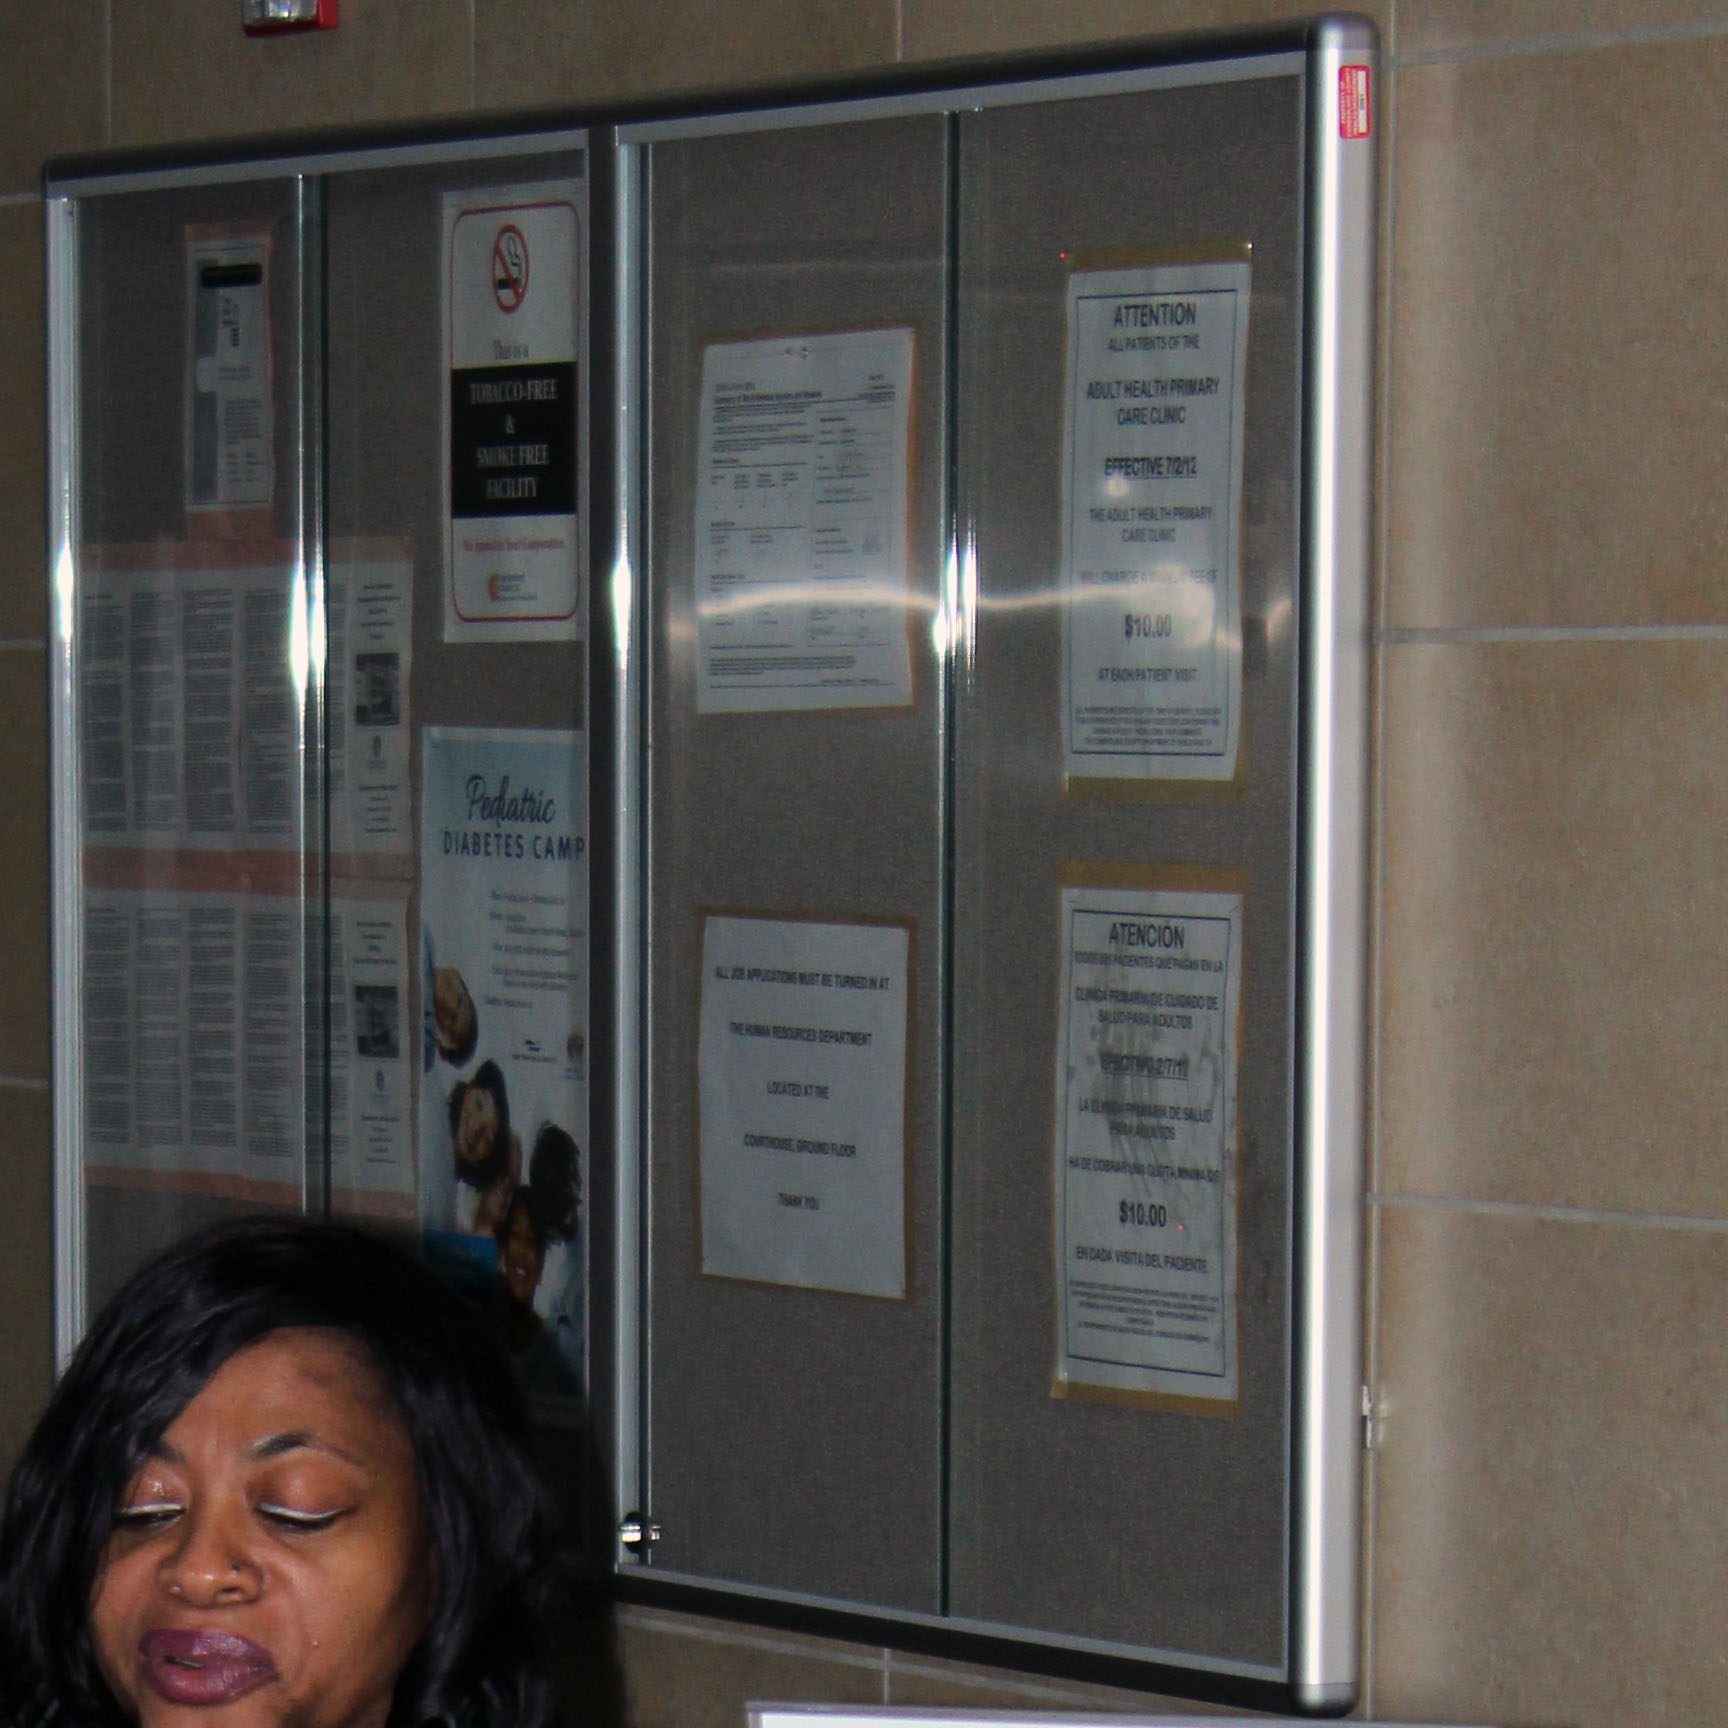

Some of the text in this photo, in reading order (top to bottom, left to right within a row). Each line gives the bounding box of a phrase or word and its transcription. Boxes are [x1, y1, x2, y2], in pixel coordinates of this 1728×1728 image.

[1114, 302, 1196, 328] ATTENTION
[1126, 336, 1166, 351] PATIENTS
[1169, 336, 1181, 350] OF
[470, 379, 558, 405] TOBACCO-FREE
[1087, 376, 1220, 399] ADULT HEALTH PRIMARY
[1117, 406, 1186, 425] CARE CLINIC
[476, 444, 549, 468] SMOKE FREE
[1105, 456, 1163, 477] EFFECTIVE
[486, 476, 539, 499] FACILITY
[1125, 613, 1172, 642] $10.00
[465, 774, 556, 828] Pediatric
[443, 830, 586, 861] DIABETES CAMP
[1213, 960, 1224, 973] LA
[773, 1025, 817, 1041] RESOURCES
[819, 1029, 872, 1045] DEPARTMENT
[767, 1080, 801, 1096] LOCATED
[804, 1083, 813, 1096] AT
[831, 1142, 856, 1158] FLOOR
[1119, 1200, 1167, 1228] $10.00
[1090, 1247, 1112, 1262] CADA
[1115, 1249, 1143, 1265] VISITA
[1145, 1252, 1163, 1268] DEL
